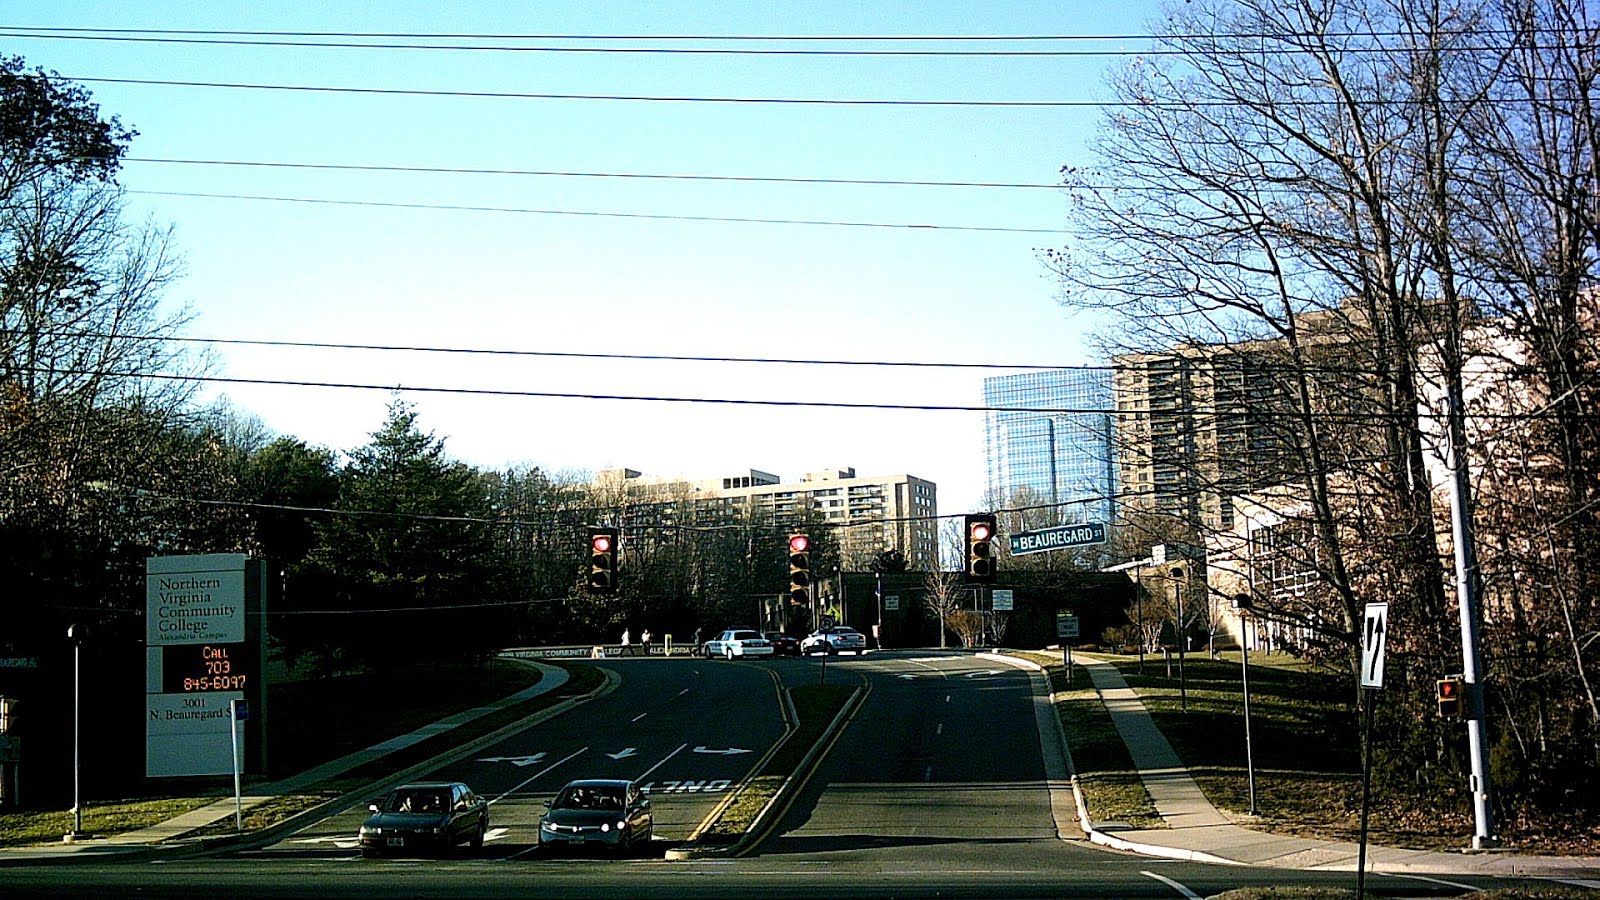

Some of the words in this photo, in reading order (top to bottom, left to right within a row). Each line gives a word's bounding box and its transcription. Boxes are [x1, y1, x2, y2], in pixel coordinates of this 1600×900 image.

[1020, 527, 1093, 550] BEAUREGARD
[1094, 529, 1102, 537] ST
[159, 576, 221, 591] Northern
[159, 590, 212, 607] Virginia
[158, 603, 236, 618] Community
[158, 618, 208, 633] College
[159, 632, 196, 640] Alexandria
[198, 631, 227, 639] Campus
[205, 660, 230, 674] 703
[183, 674, 246, 691] 845-6097
[182, 698, 205, 708] 3001
[165, 708, 223, 720] Beauregard
